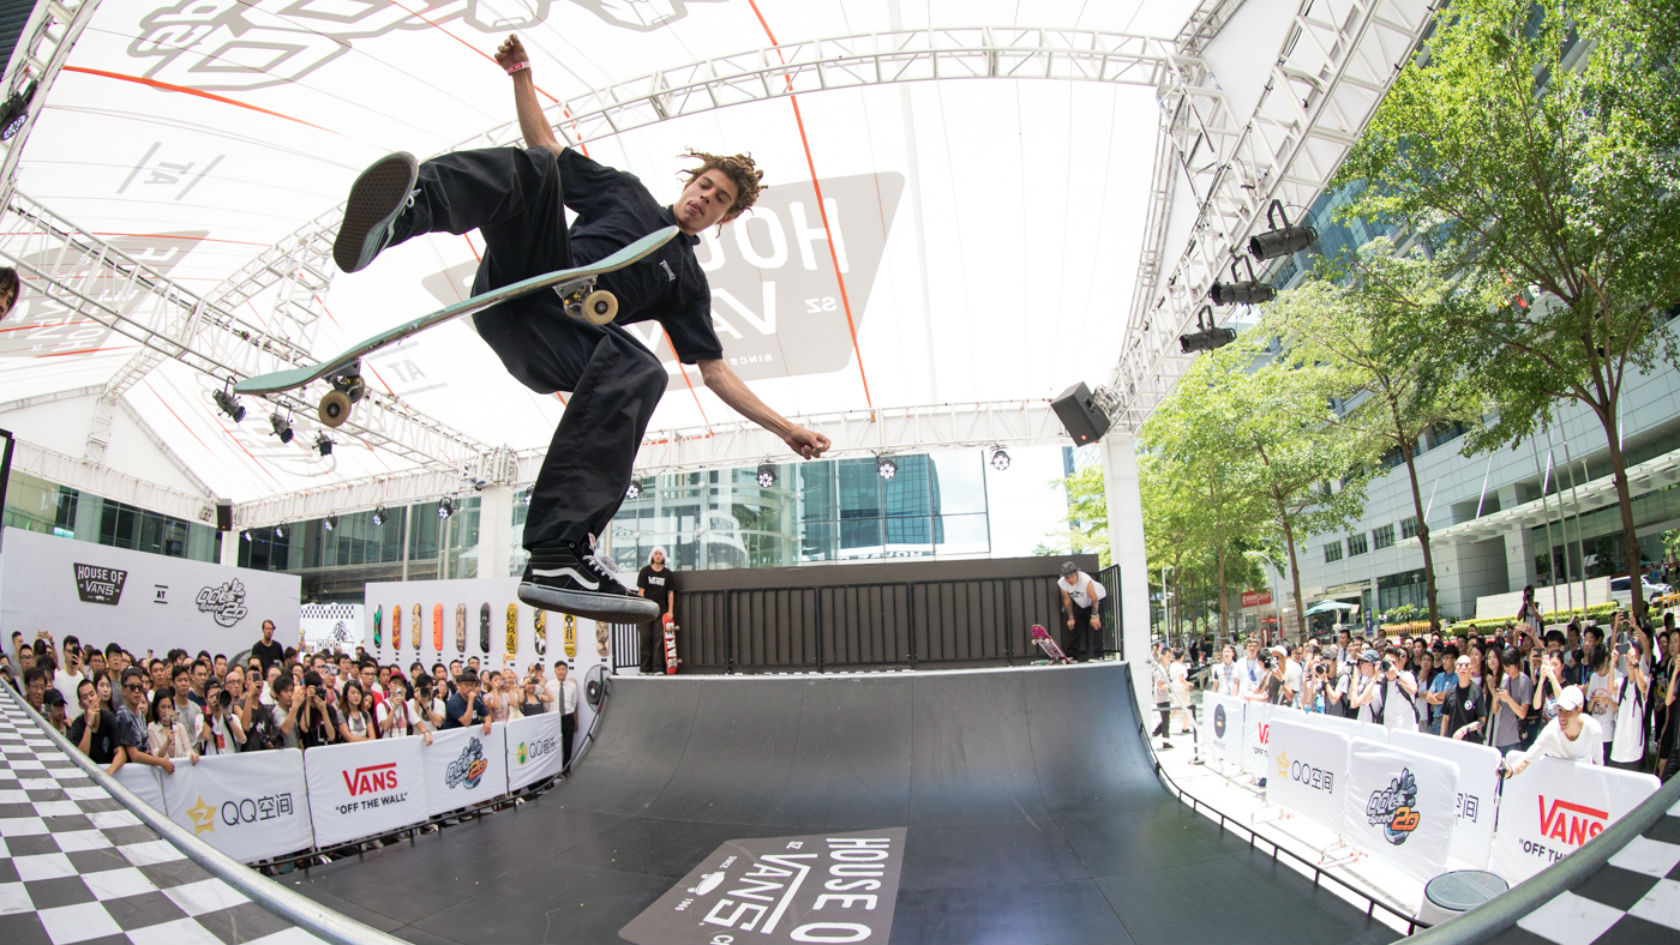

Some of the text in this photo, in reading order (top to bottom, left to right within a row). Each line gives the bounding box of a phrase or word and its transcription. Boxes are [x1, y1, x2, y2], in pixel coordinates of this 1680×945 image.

[77, 565, 124, 584] HOUSE OF
[85, 580, 116, 596] VANS
[156, 590, 166, 599] AT
[342, 762, 398, 797] VANS
[1292, 760, 1335, 794] QQ空间
[221, 792, 294, 826] QQ空间
[335, 791, 408, 815] "OFF THE WALL"
[1538, 794, 1609, 848] VANS
[1519, 838, 1567, 864] "OFF TH
[812, 838, 891, 910] HOUSE
[703, 853, 818, 934] VANS
